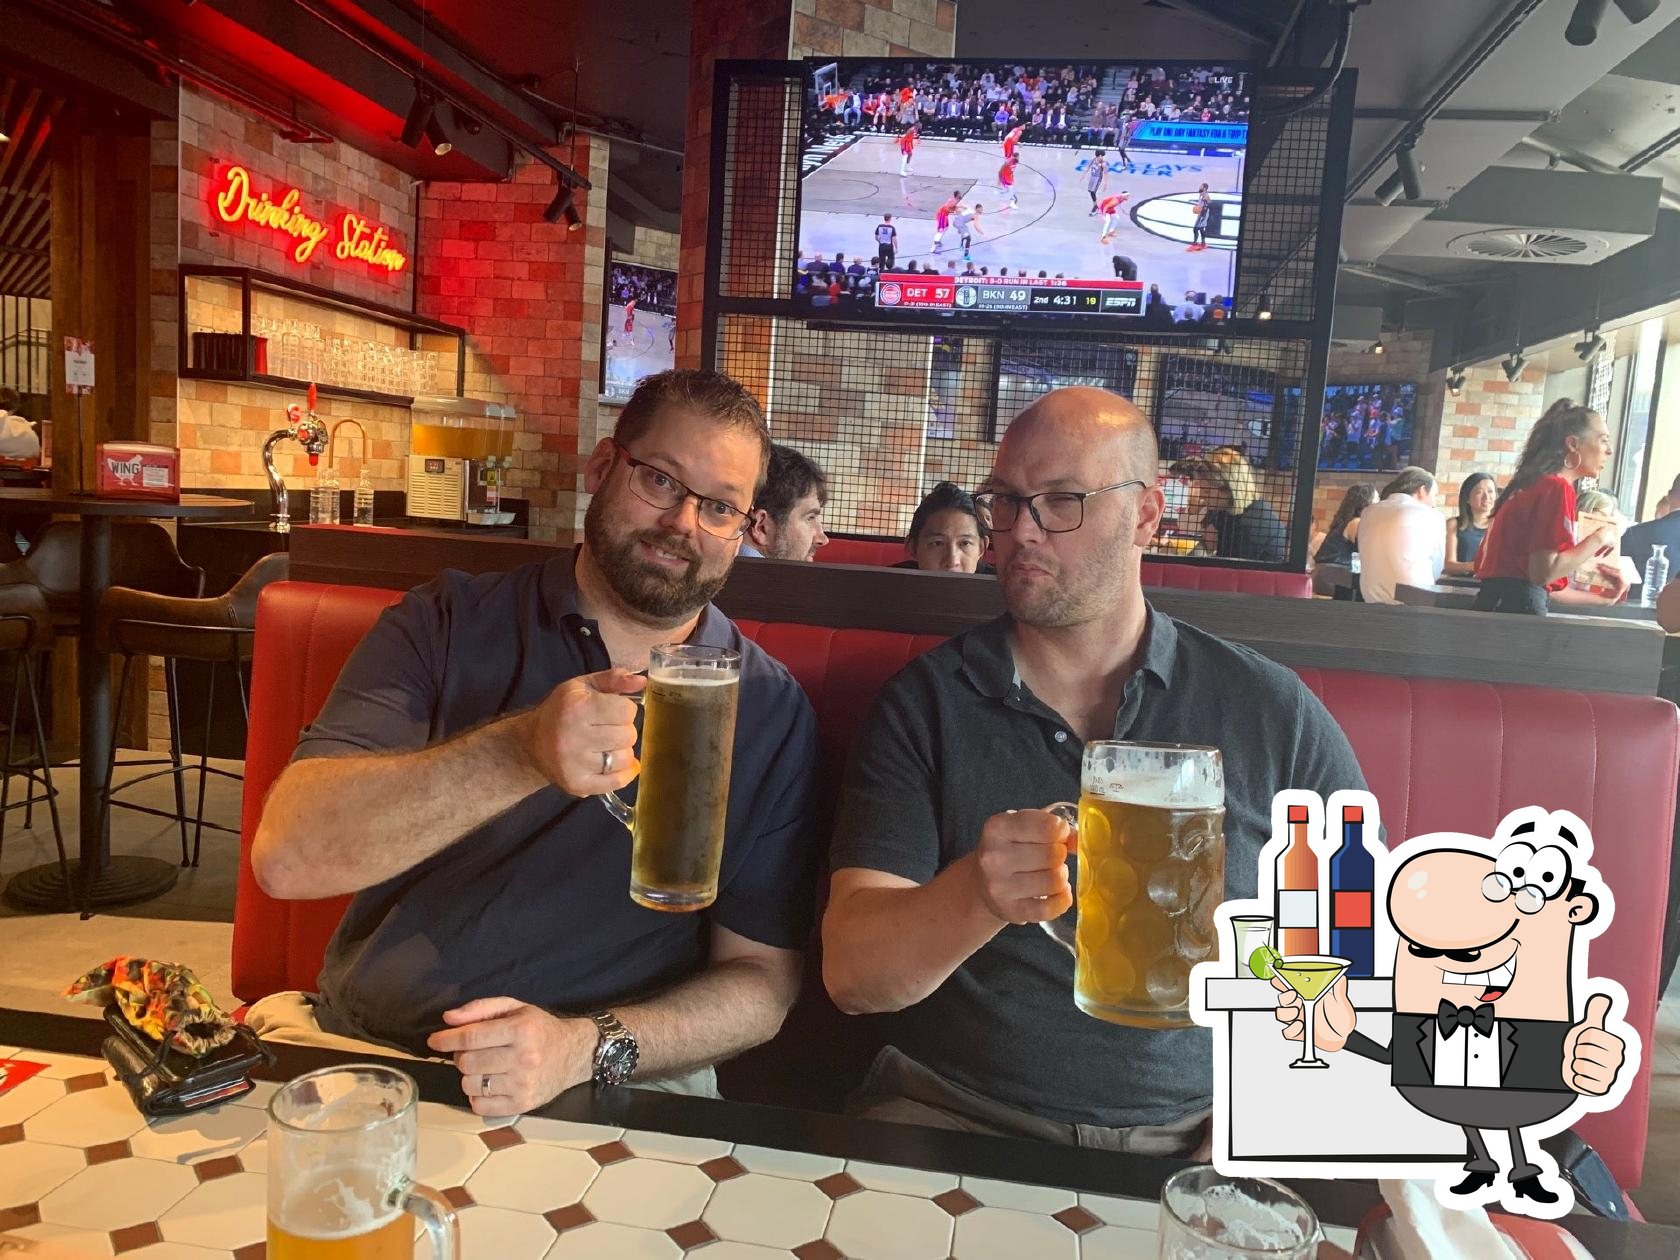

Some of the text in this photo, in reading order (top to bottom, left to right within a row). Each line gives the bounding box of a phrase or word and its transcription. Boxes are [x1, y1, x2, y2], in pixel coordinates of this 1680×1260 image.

[1214, 76, 1233, 84] LIVE
[217, 166, 407, 271] Drinking Station
[906, 288, 928, 298] DET
[935, 288, 950, 299] 57
[983, 290, 1026, 301] BKN 49
[1033, 295, 1097, 305] 2nd 4:31 19
[1105, 297, 1137, 307] ESPN
[111, 461, 140, 474] WING
